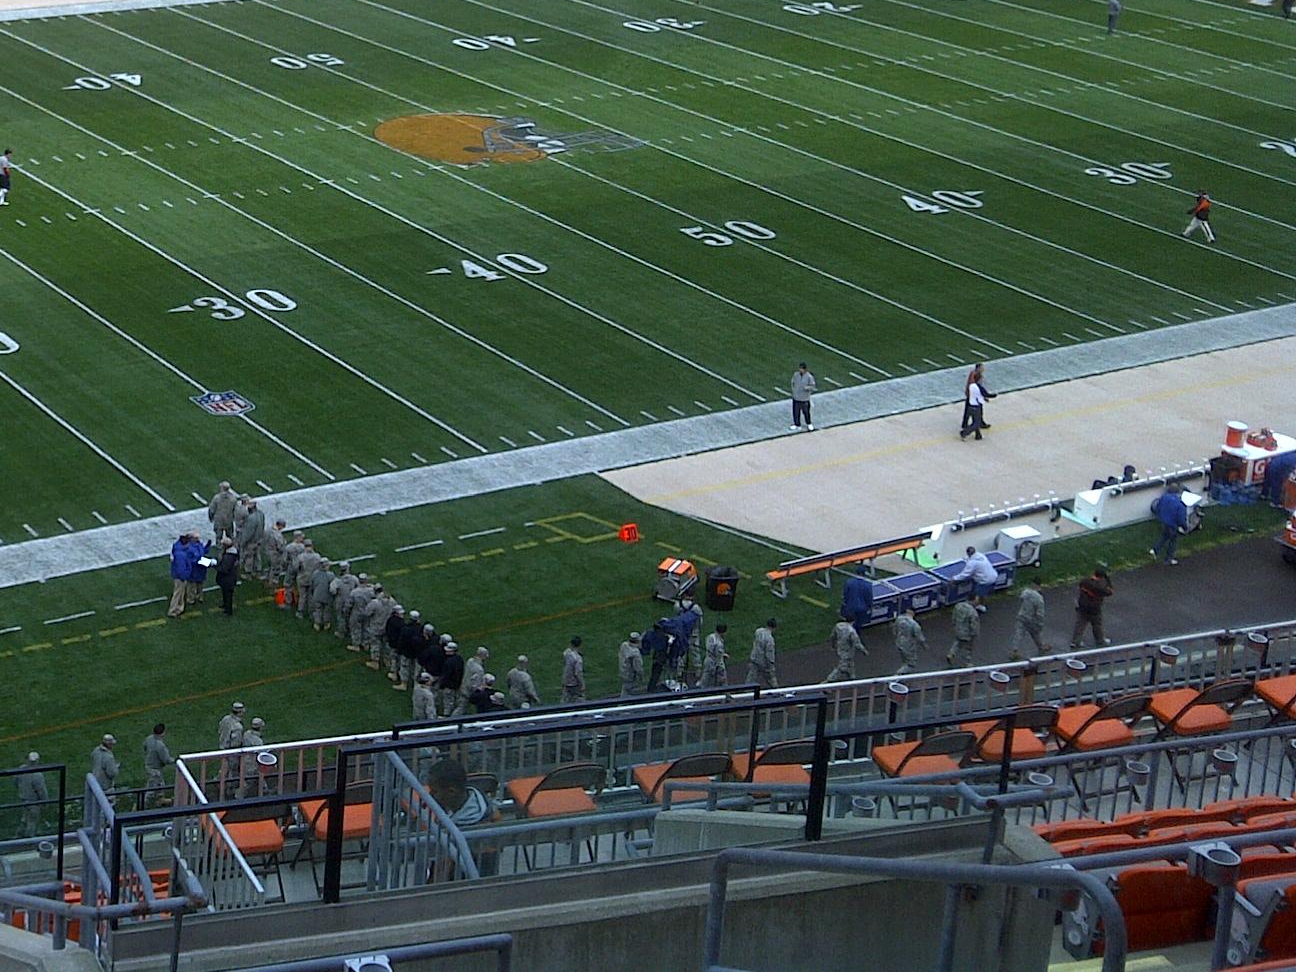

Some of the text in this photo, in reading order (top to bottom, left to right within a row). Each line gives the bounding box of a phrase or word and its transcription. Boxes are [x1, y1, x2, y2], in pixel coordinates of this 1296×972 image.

[271, 53, 344, 71] 50
[74, 72, 144, 92] 40
[1084, 162, 1173, 185] 30
[901, 190, 984, 215] 40
[680, 219, 776, 248] 50
[458, 253, 549, 282] 40
[192, 288, 298, 321] 30
